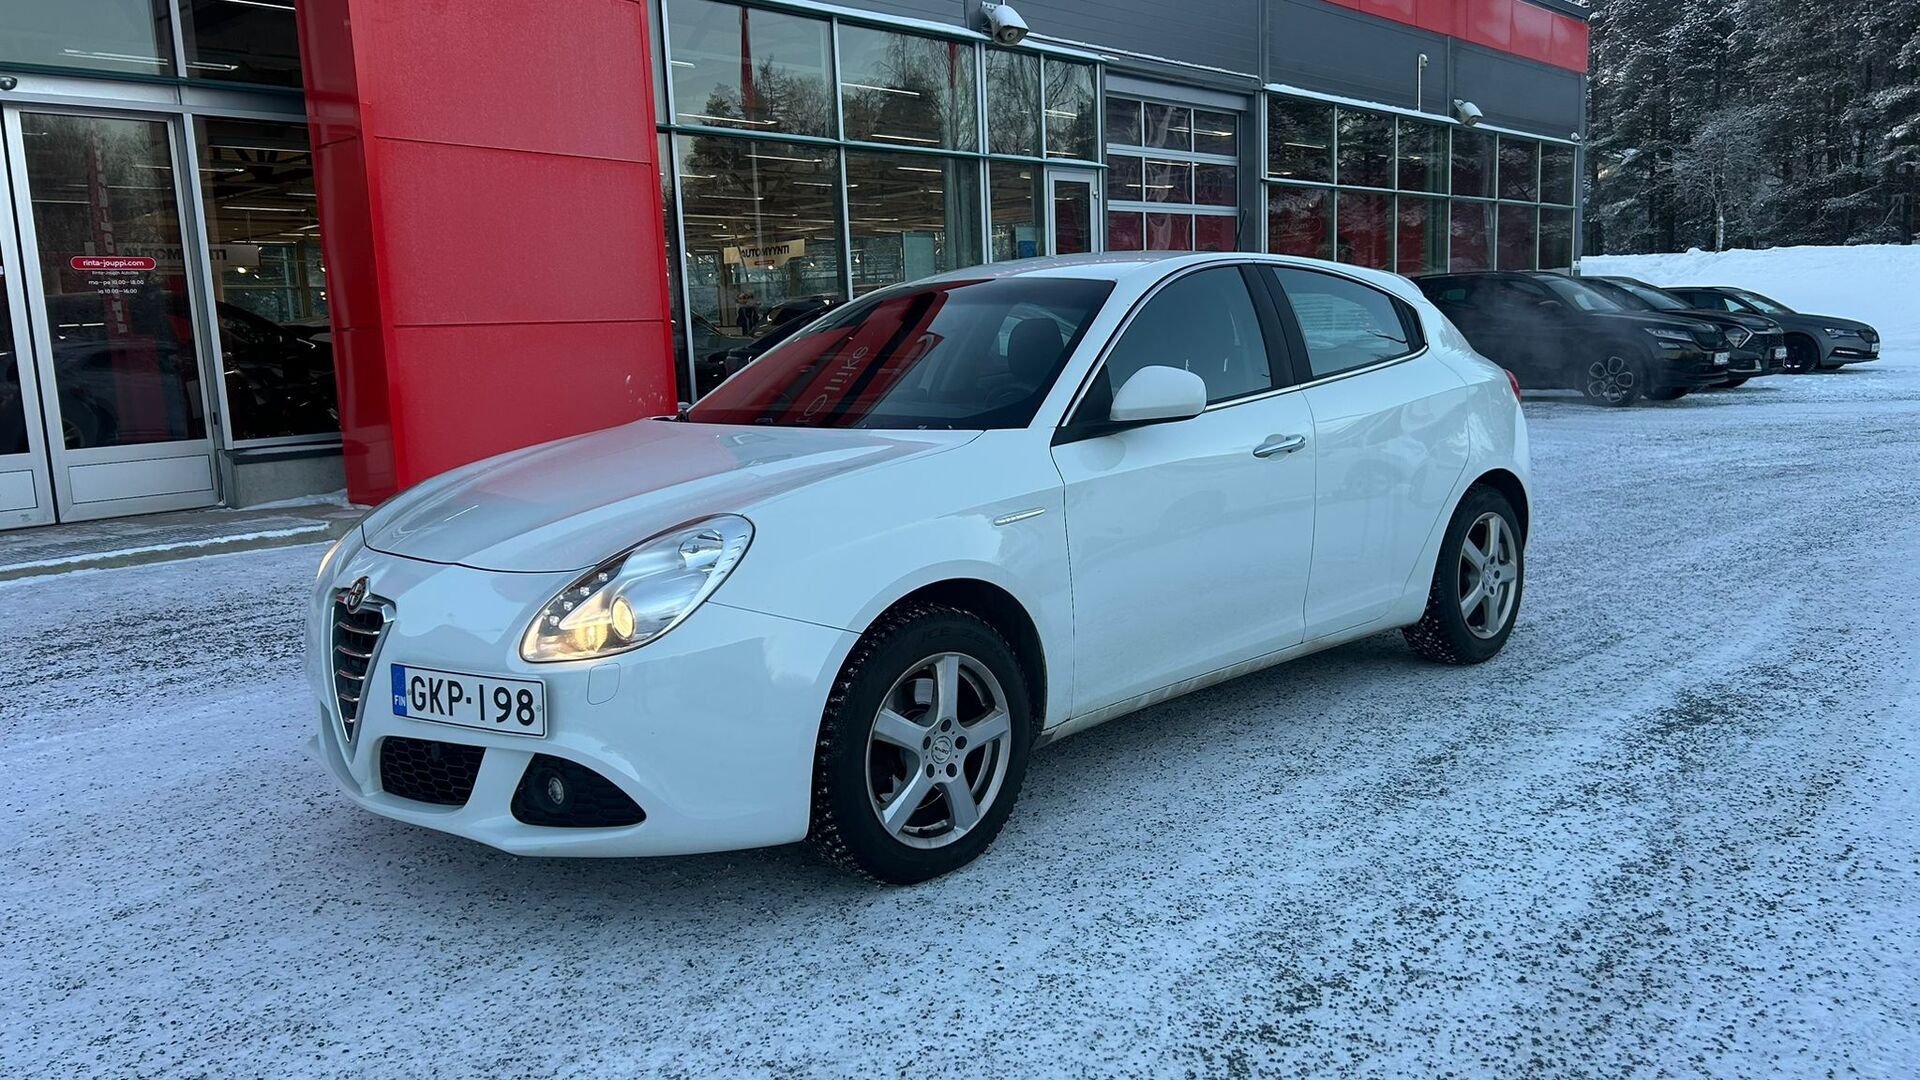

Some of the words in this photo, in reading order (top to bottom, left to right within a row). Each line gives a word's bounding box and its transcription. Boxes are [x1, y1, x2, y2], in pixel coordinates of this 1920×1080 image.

[122, 247, 227, 260] AUTOMTI
[741, 245, 789, 258] AUTOMYYNTI
[83, 260, 144, 268] rinta-jouppi.com
[395, 695, 405, 707] FIN
[411, 675, 535, 726] GKP-198
